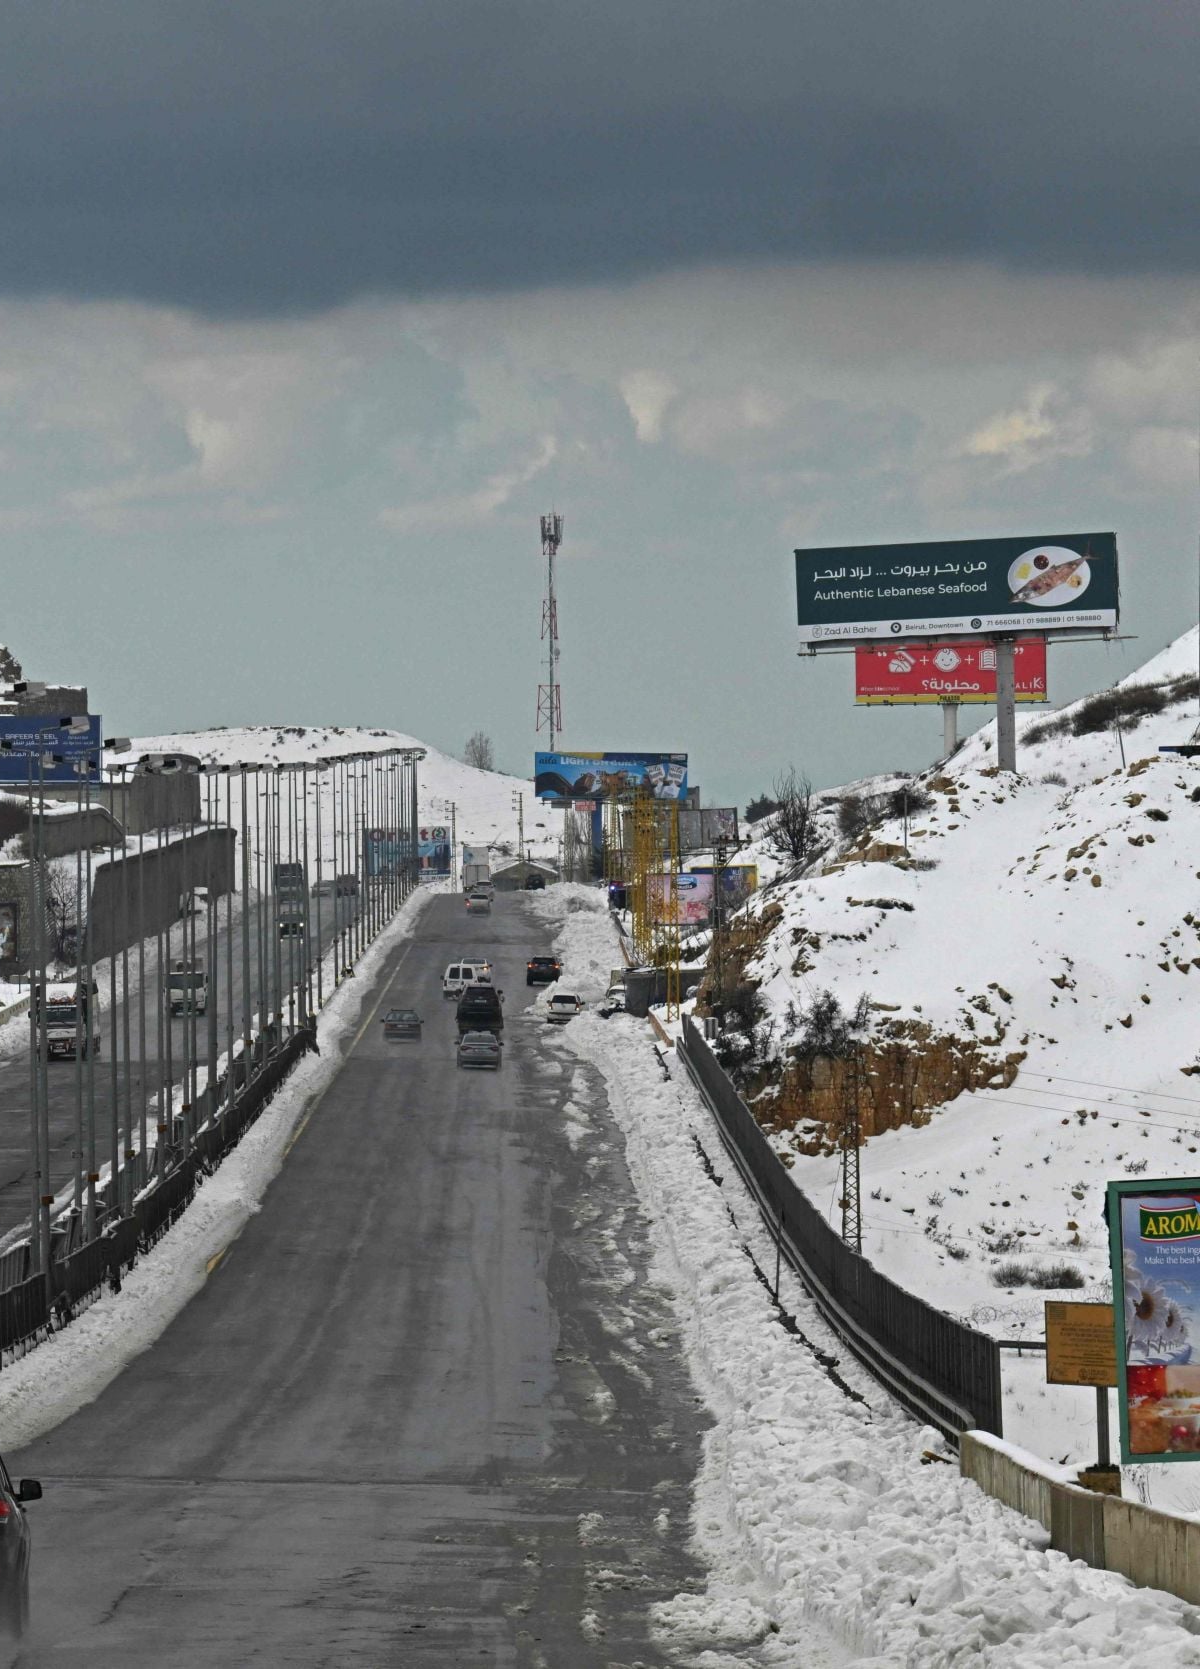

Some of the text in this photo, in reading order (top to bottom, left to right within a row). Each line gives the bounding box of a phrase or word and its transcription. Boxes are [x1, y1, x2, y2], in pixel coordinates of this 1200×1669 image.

[849, 566, 872, 580] لزاد
[890, 565, 931, 578] بيروت
[933, 563, 960, 576] بحر
[963, 561, 987, 574] من
[813, 567, 846, 583] البحر
[813, 581, 987, 601] Authentic Lebanese Seafood
[824, 627, 841, 636] Zad
[852, 626, 878, 634] Baher
[921, 677, 980, 692] محلولة؟
[1015, 677, 1045, 689] ALIKS
[1144, 1213, 1200, 1235] AROM
[1155, 1246, 1170, 1255] The
[1171, 1246, 1186, 1255] best
[1144, 1256, 1165, 1265] Make
[1166, 1256, 1179, 1265] the
[1180, 1256, 1195, 1265] best
